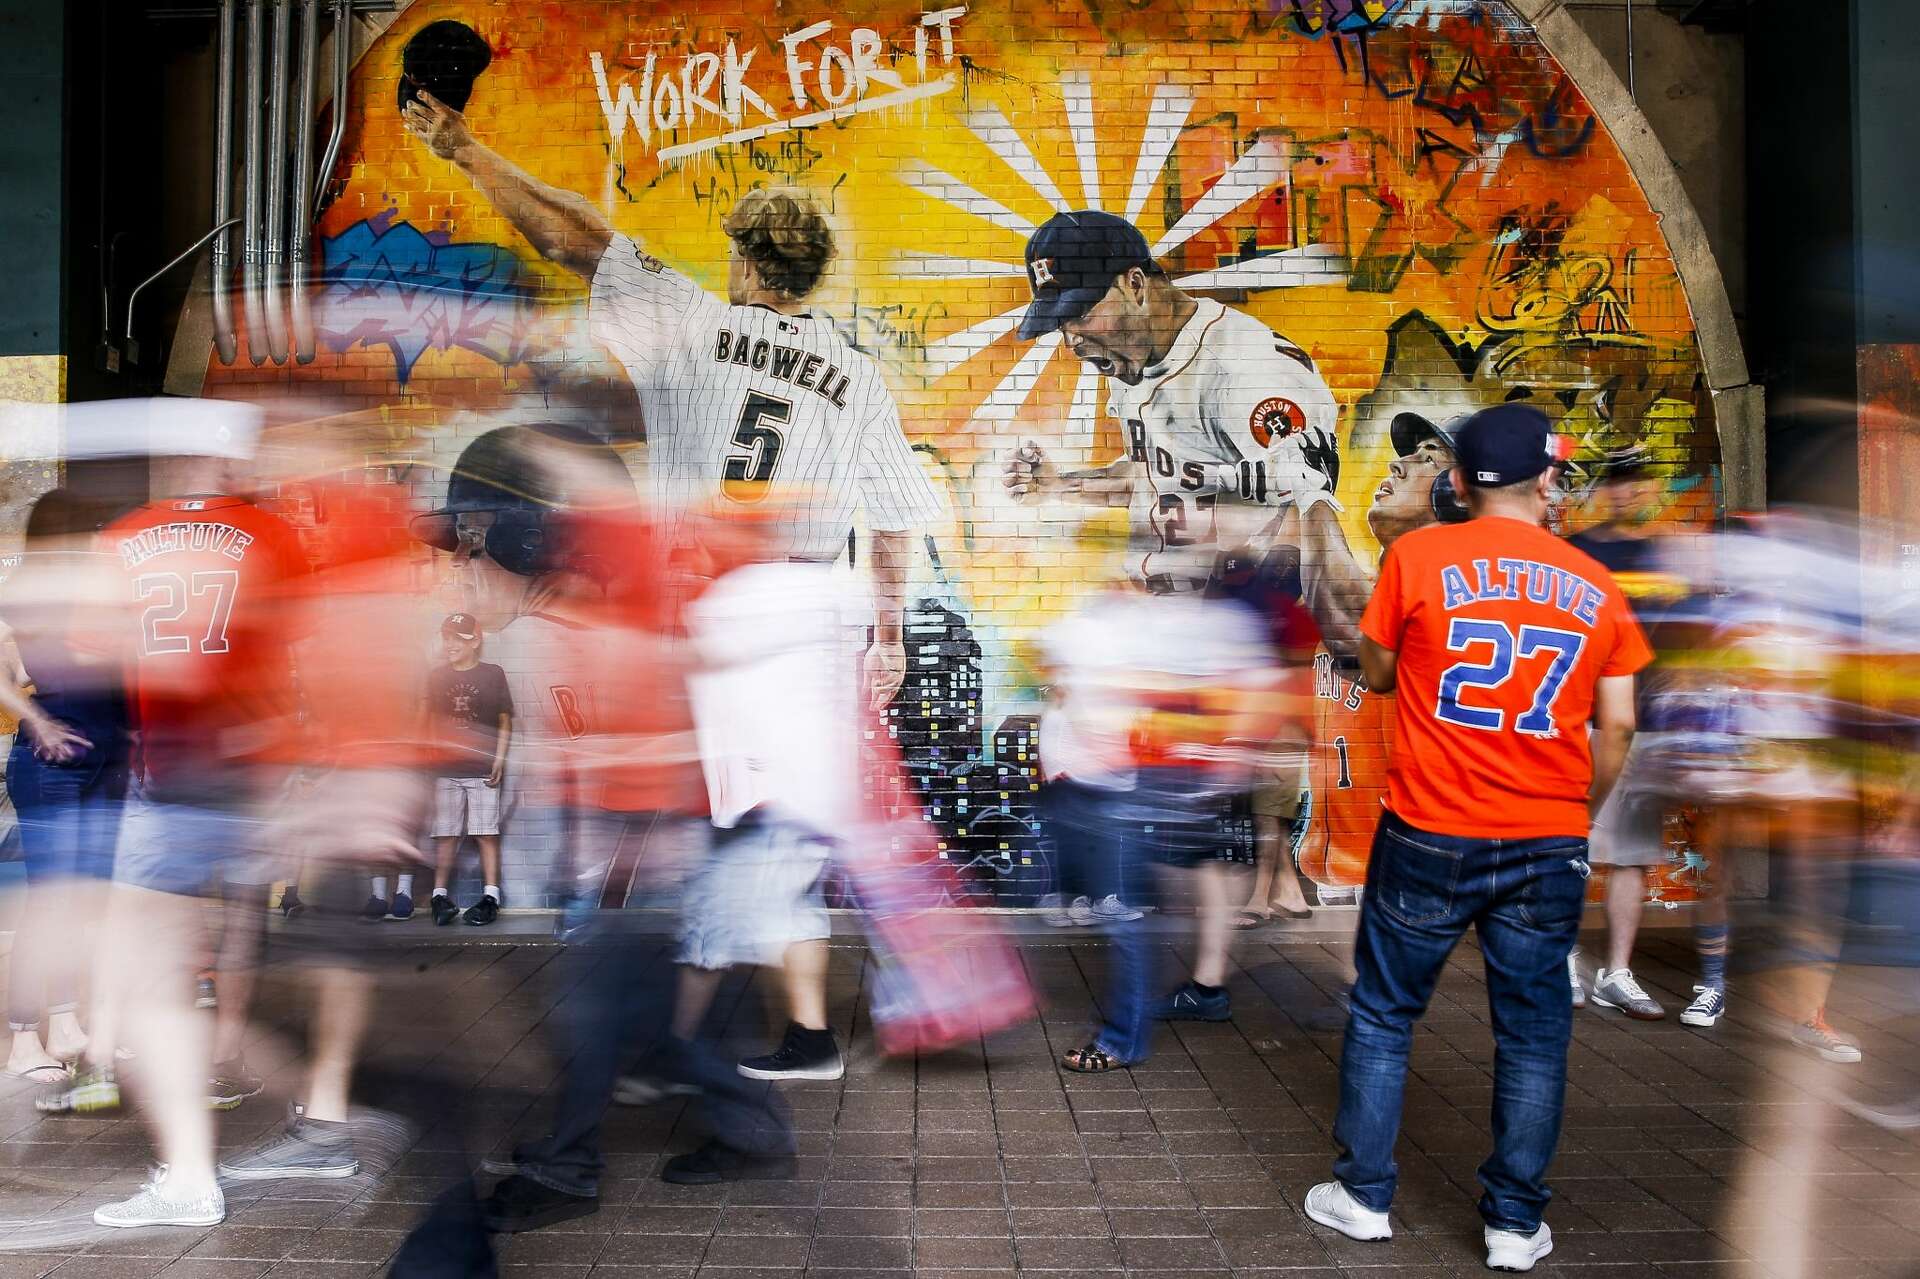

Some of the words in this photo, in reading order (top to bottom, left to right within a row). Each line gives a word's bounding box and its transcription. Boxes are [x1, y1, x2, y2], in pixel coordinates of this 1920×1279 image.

[589, 37, 778, 145] WORK
[778, 19, 906, 110] FOR
[914, 5, 970, 75] IT
[1030, 258, 1053, 287] H
[715, 329, 850, 410] BAGWELL
[720, 388, 793, 504] 5
[1253, 400, 1291, 427] HOUSTON
[1266, 416, 1286, 436] H
[133, 570, 239, 656] 27
[1440, 557, 1607, 628] ALTUVE
[1434, 617, 1588, 735] 27
[1334, 736, 1352, 789] 1
